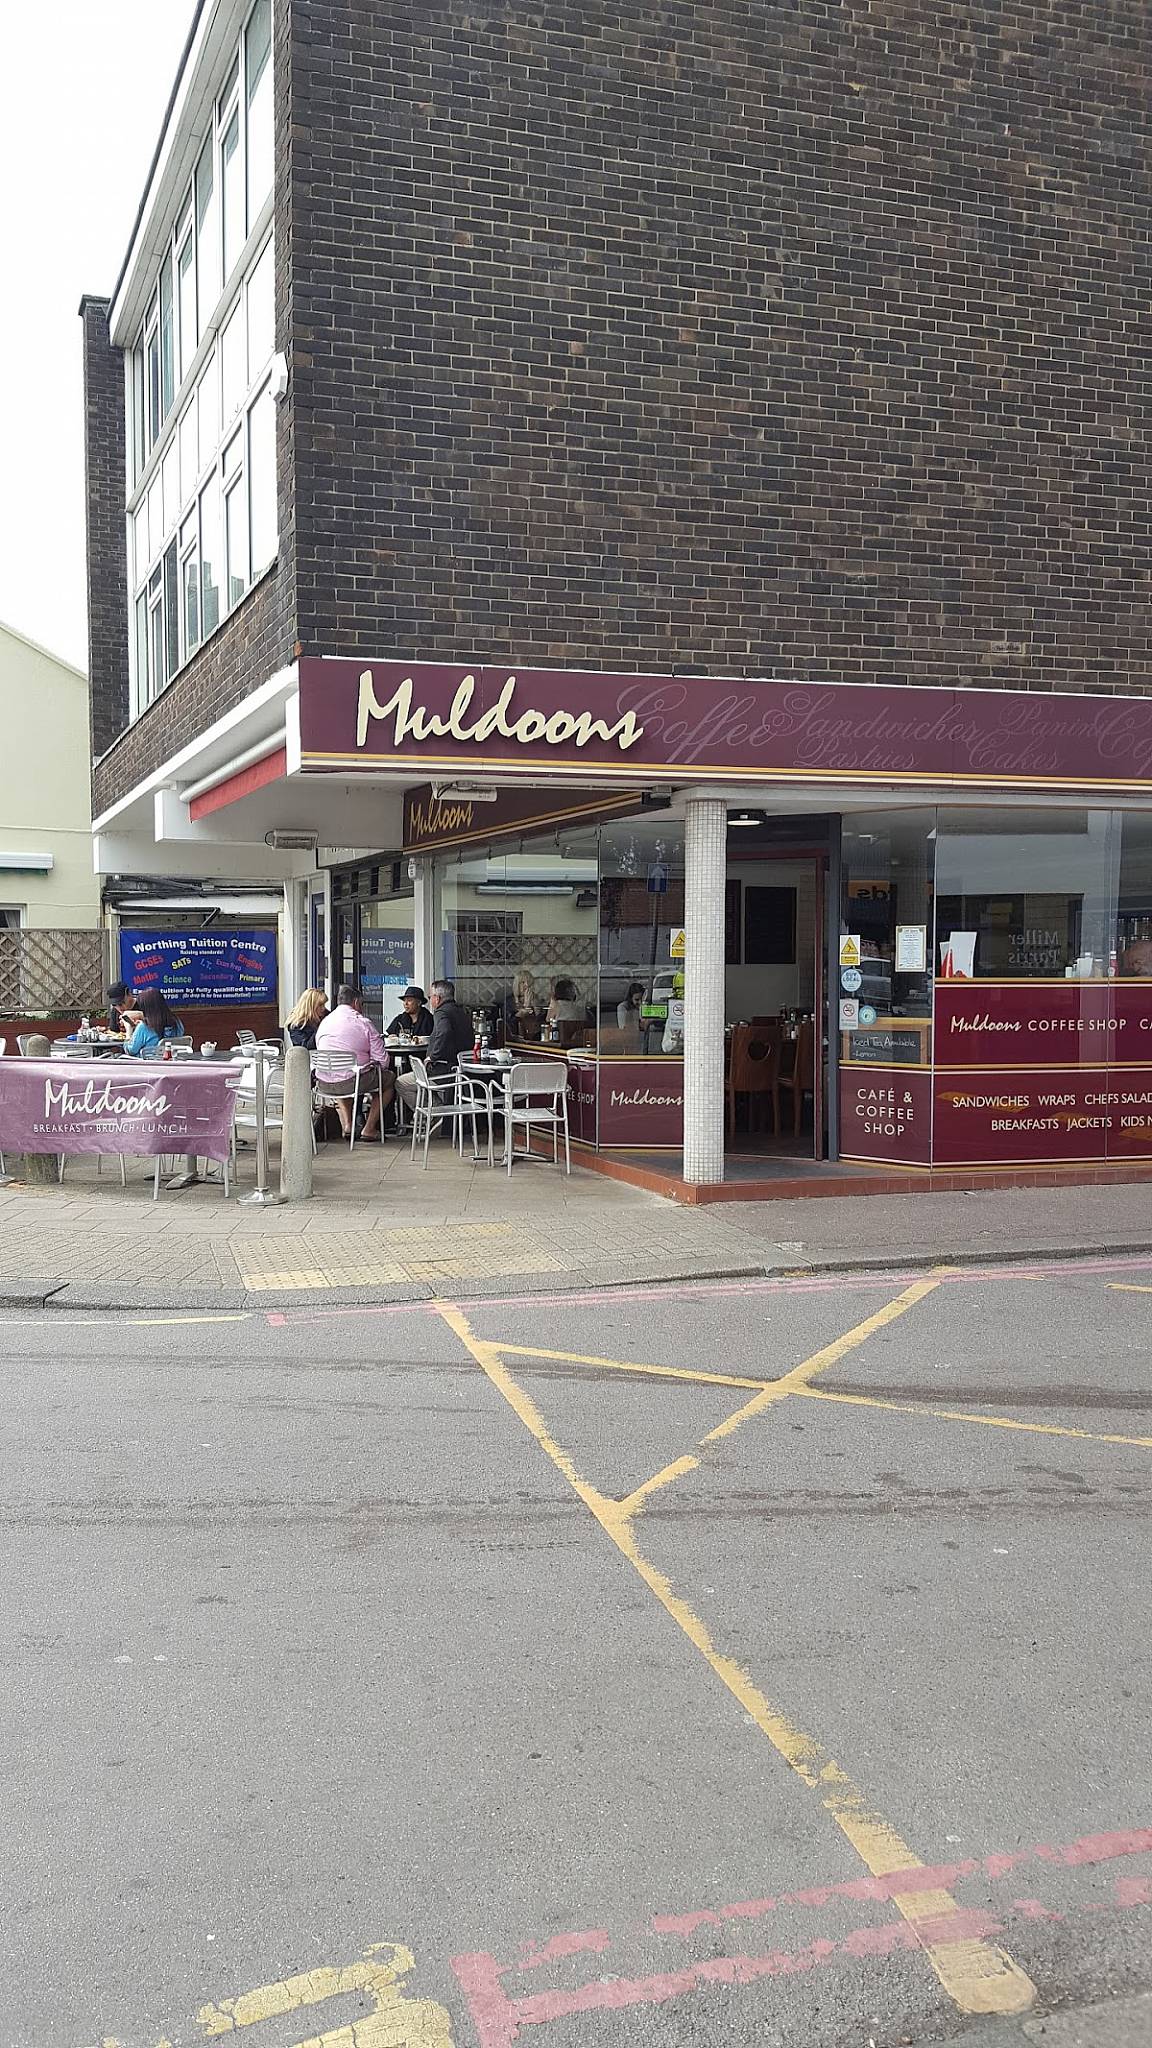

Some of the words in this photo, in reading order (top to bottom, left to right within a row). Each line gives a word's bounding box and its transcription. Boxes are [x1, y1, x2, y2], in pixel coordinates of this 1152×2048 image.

[357, 669, 644, 749] Muldoons
[762, 690, 982, 743] Sandwiches
[616, 684, 777, 763] Coffee
[793, 736, 918, 769] Pastries
[968, 730, 1062, 770] Cakes
[409, 793, 474, 843] Muldoons
[132, 939, 187, 954] Worthing
[189, 938, 228, 948] Tuition
[230, 939, 267, 953] Centre
[171, 957, 191, 970] SATs
[238, 954, 263, 971] English
[133, 972, 158, 985] Maths
[163, 974, 192, 983] Science
[239, 974, 265, 983] Primary
[951, 1014, 1022, 1032] Muldoons
[1028, 1019, 1084, 1031] COFFEE
[1088, 1019, 1127, 1031] SHOP
[45, 1078, 172, 1118] Muldoons
[577, 1092, 595, 1105] SHOP
[610, 1089, 684, 1107] Muldoons
[857, 1087, 895, 1102] CAFÉ
[903, 1091, 913, 1103] &
[952, 1095, 1030, 1108] SANDWICHES
[1038, 1094, 1076, 1106] WRAPS
[1084, 1093, 1119, 1105] CHEFS
[855, 1104, 914, 1120] COFFEE
[33, 1123, 87, 1133] BREAKFAST
[96, 1123, 135, 1133] BRUNCH
[141, 1123, 188, 1134] LUNCH
[864, 1122, 905, 1136] SHOP
[991, 1118, 1060, 1131] BREAKFASTS
[1066, 1116, 1113, 1131] JACKETS
[1120, 1115, 1145, 1127] KIDS
